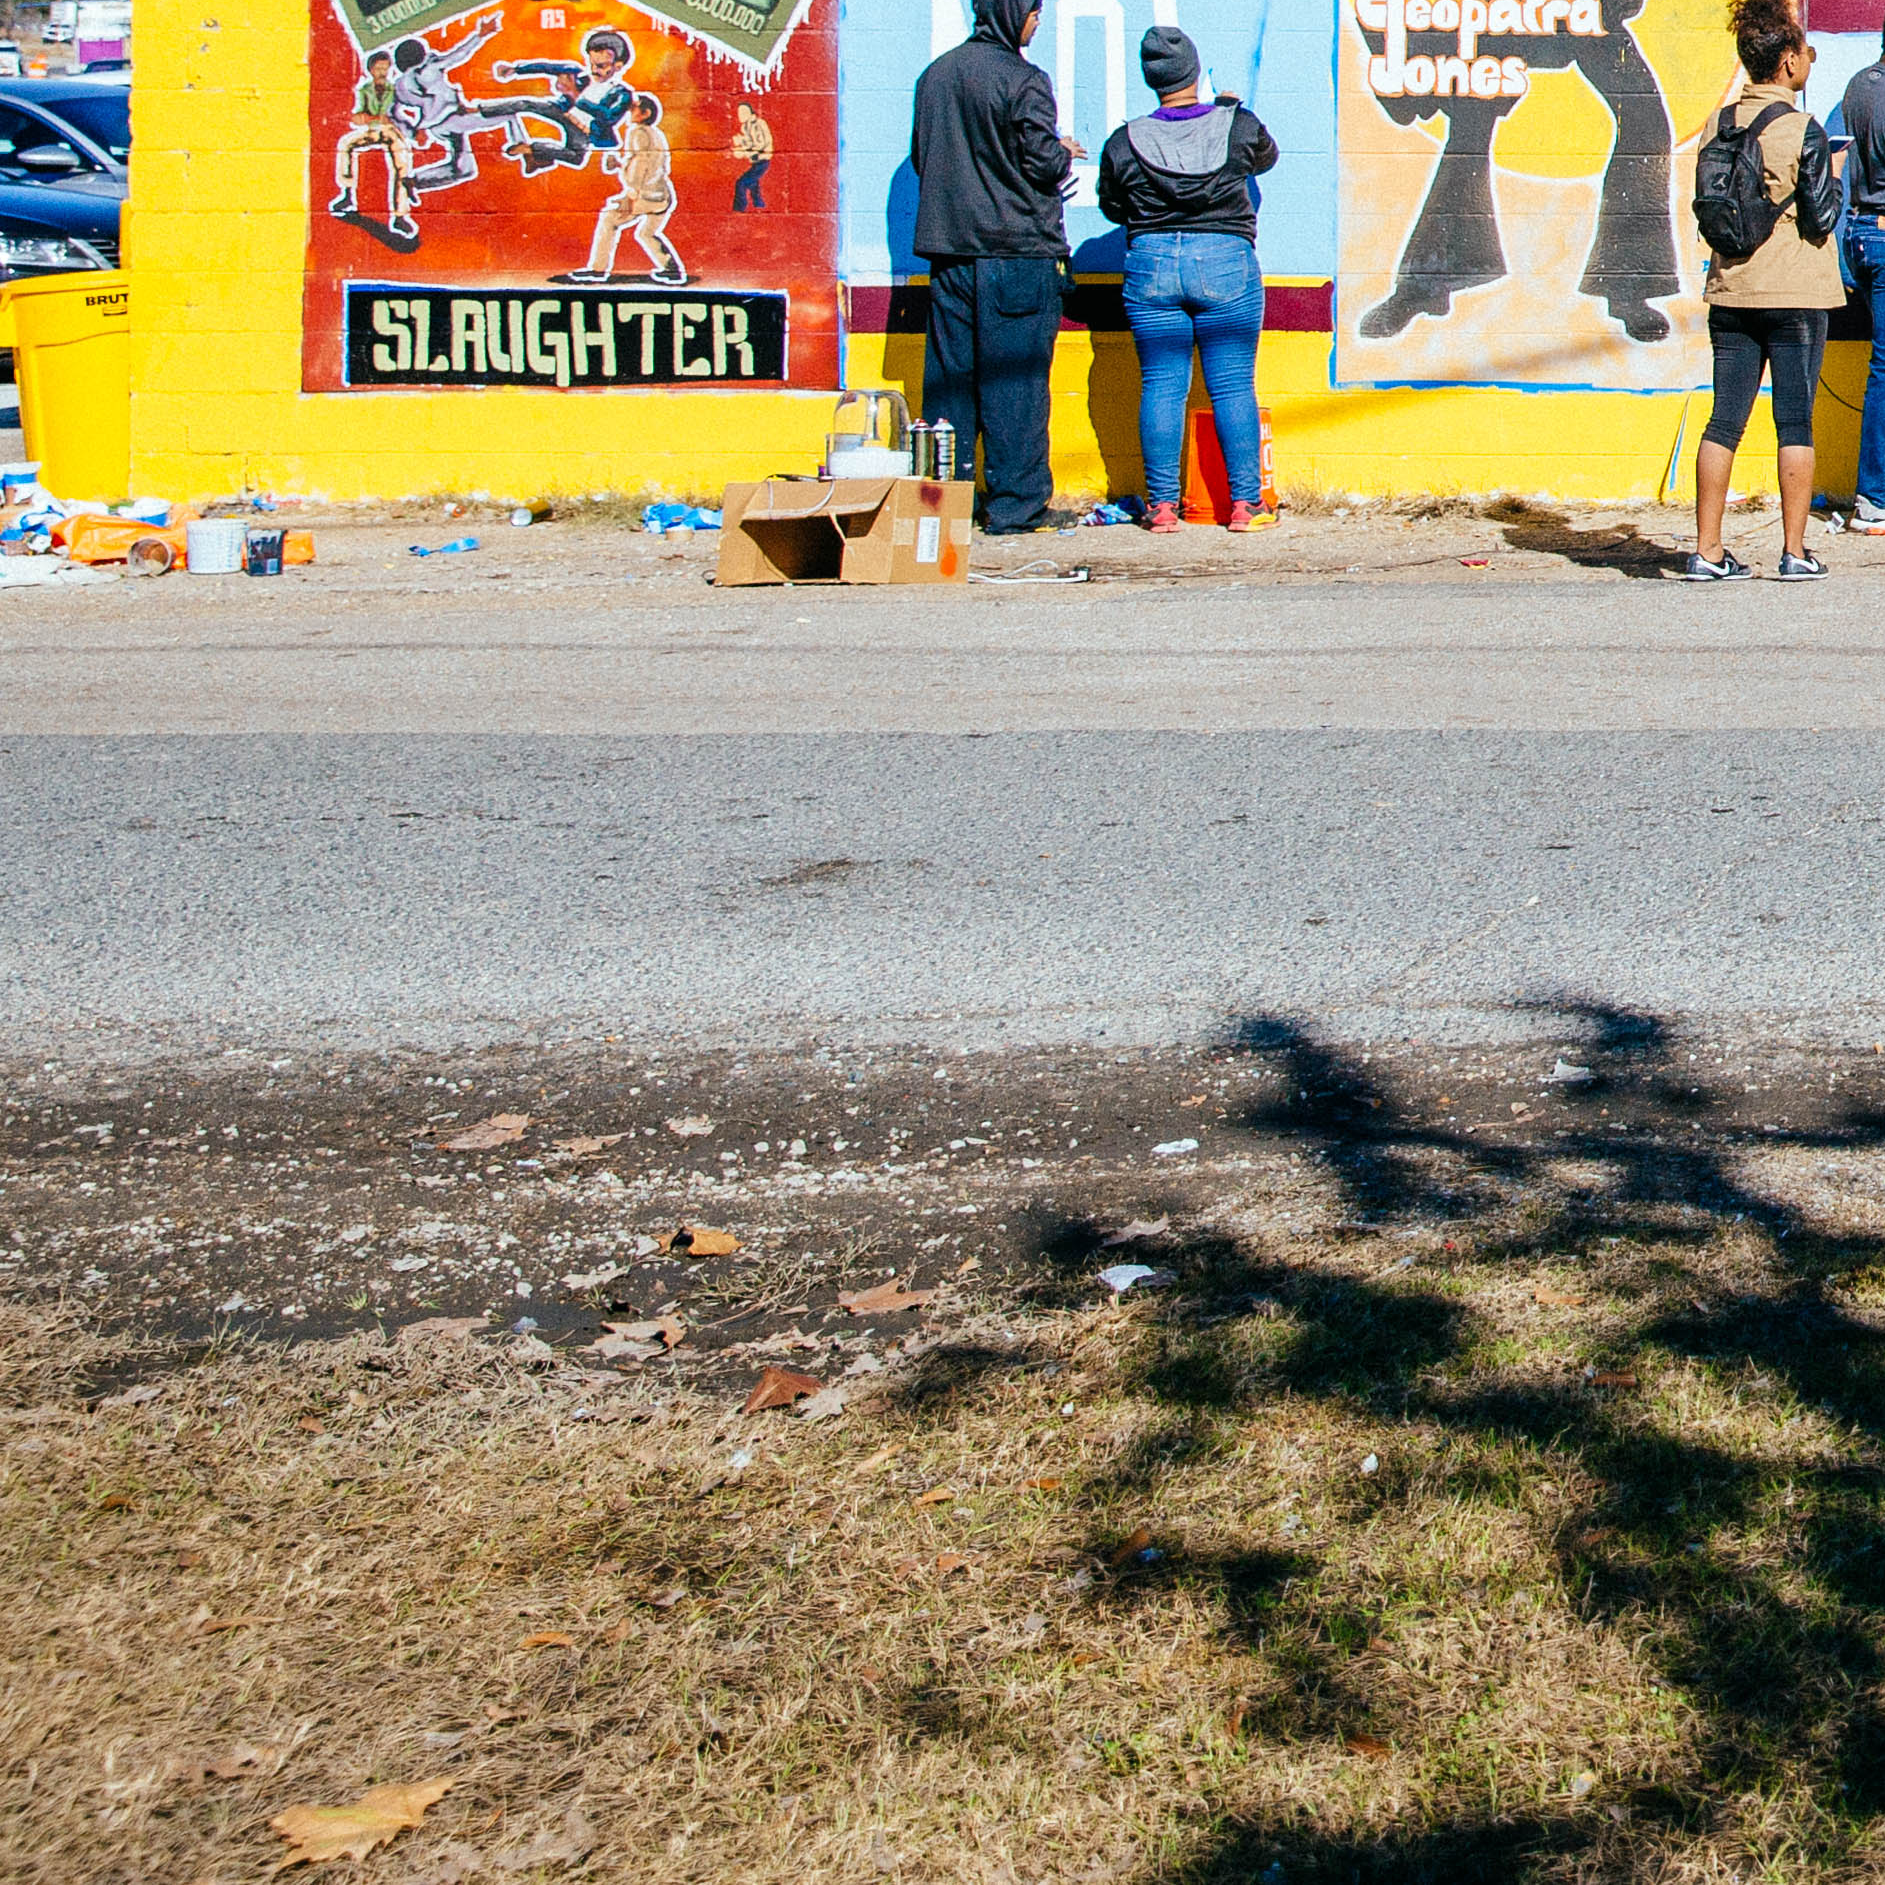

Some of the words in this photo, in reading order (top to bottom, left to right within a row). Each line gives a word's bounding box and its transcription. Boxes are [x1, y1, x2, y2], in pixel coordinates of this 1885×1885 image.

[1367, 50, 1529, 98] Jones
[85, 293, 129, 306] BRUT
[370, 298, 756, 388] SLAUGHTER
